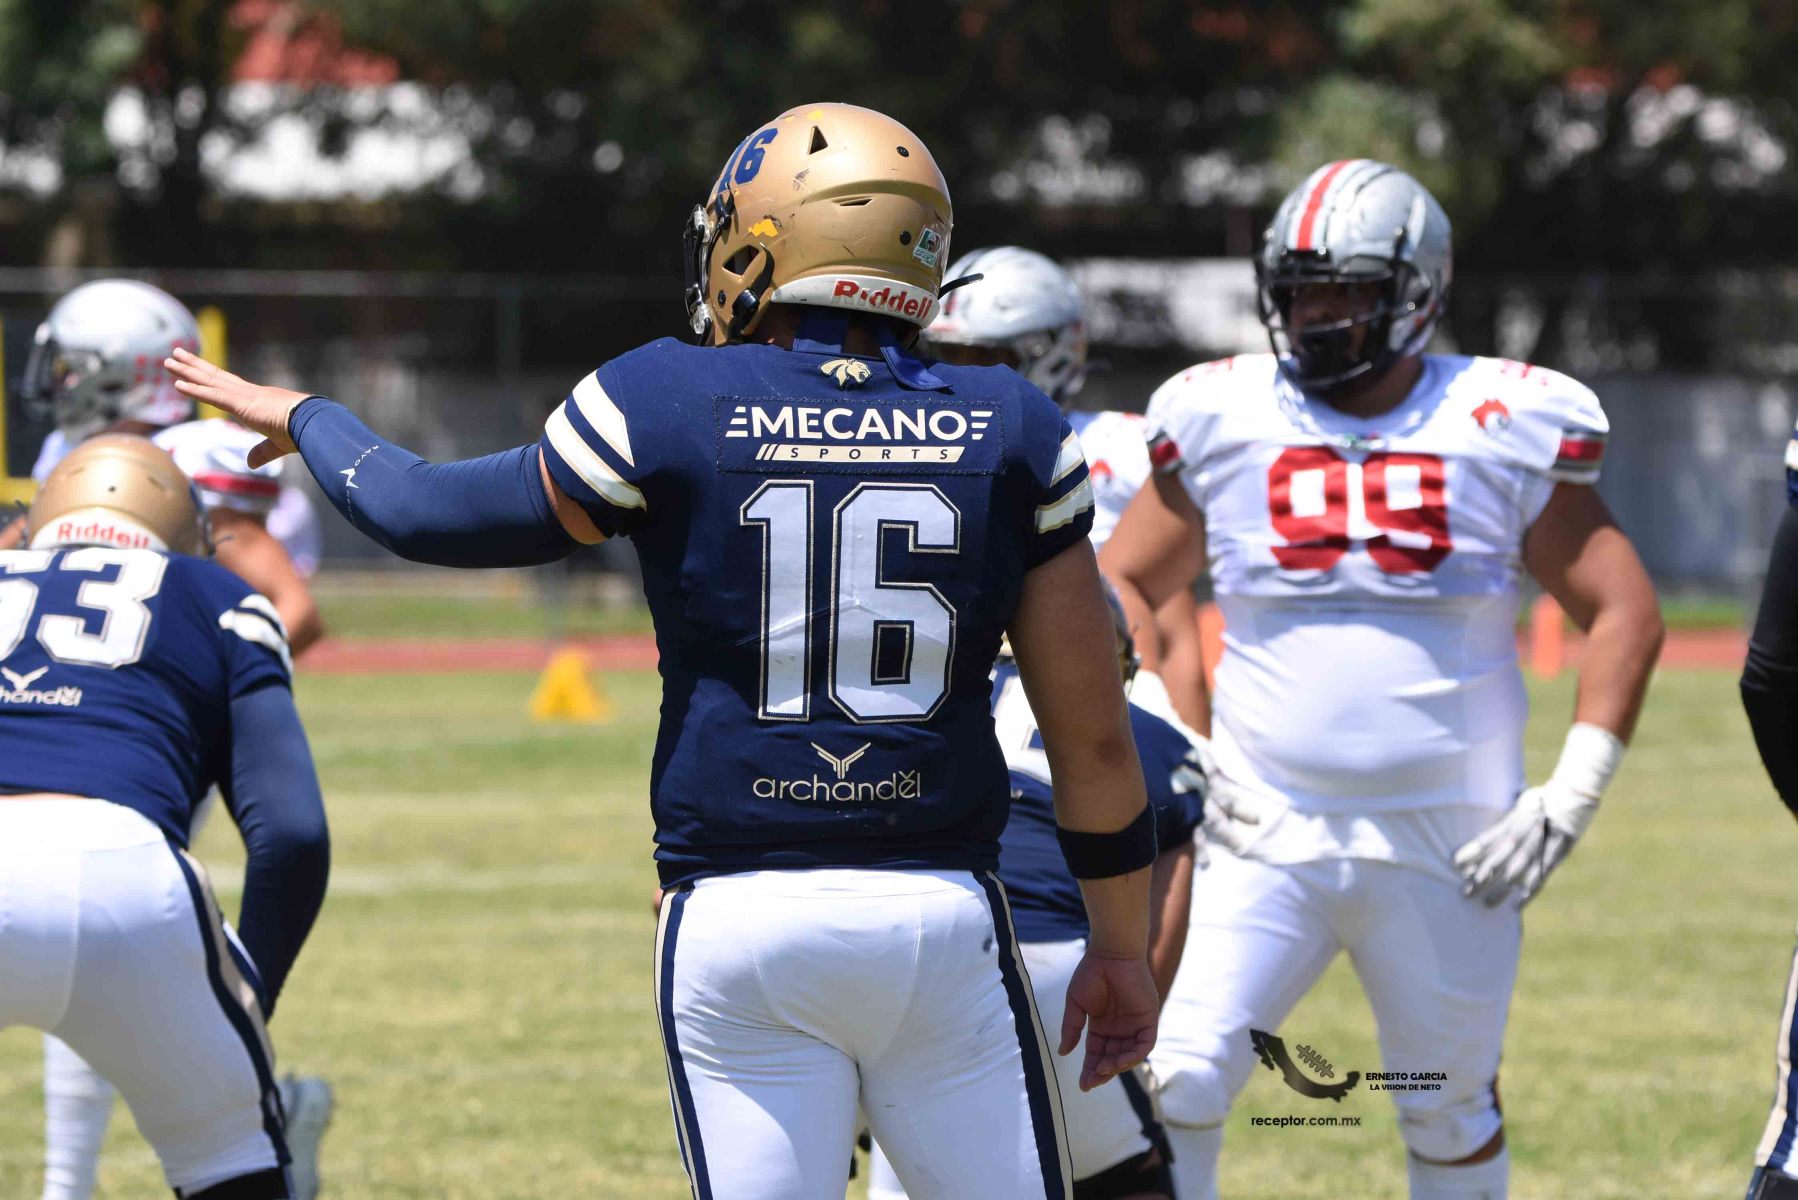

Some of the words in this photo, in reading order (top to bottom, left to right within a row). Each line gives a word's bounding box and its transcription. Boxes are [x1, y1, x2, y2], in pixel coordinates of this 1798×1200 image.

[832, 280, 933, 320] Riddell
[790, 447, 949, 460] SPORTS
[1267, 446, 1453, 575] 99
[739, 479, 962, 724] 16
